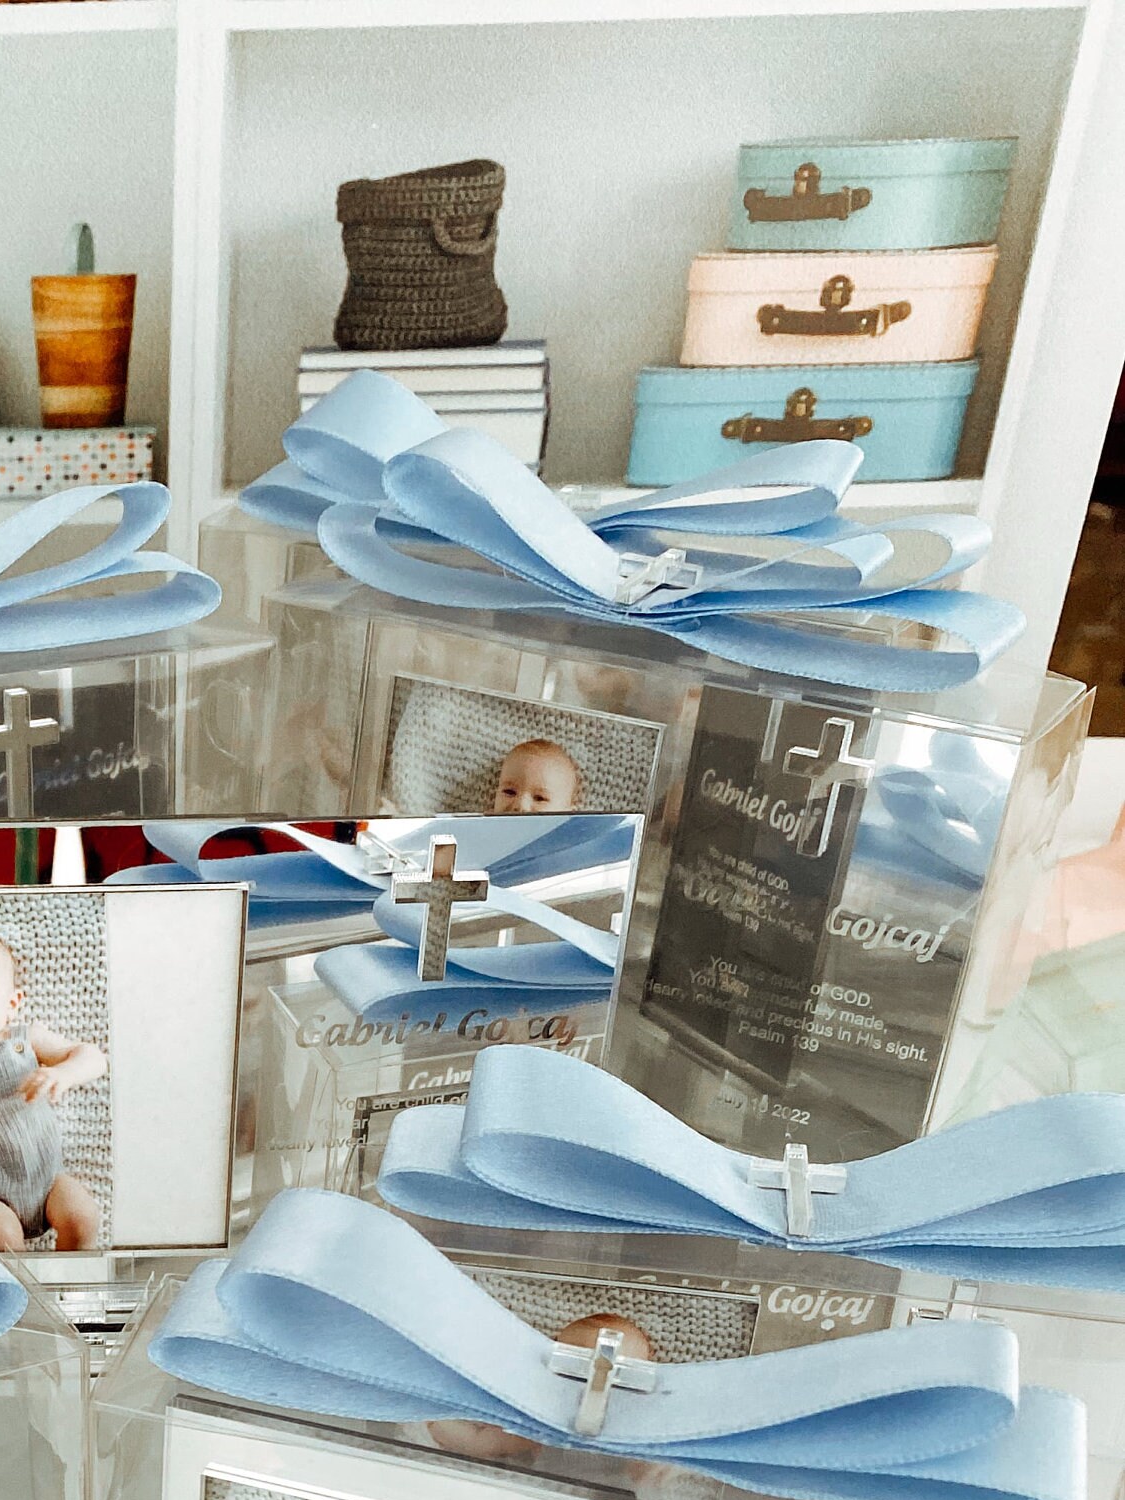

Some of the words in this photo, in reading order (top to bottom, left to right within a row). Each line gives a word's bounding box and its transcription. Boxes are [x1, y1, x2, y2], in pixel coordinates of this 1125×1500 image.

[826, 905, 950, 964] Gojcaj
[710, 955, 738, 975] You
[810, 982, 828, 996] of
[830, 986, 873, 1009] GOD.
[689, 968, 717, 988] You
[839, 1010, 888, 1034] made,
[296, 1012, 447, 1048] Gabriel
[738, 1020, 786, 1045] Psalm
[792, 1034, 820, 1052] 139
[767, 1011, 834, 1037] precious
[885, 1040, 928, 1062] sight.
[336, 1097, 367, 1112] You
[372, 1099, 401, 1111] are
[771, 1103, 811, 1125] 2022
[352, 1117, 371, 1130] ar
